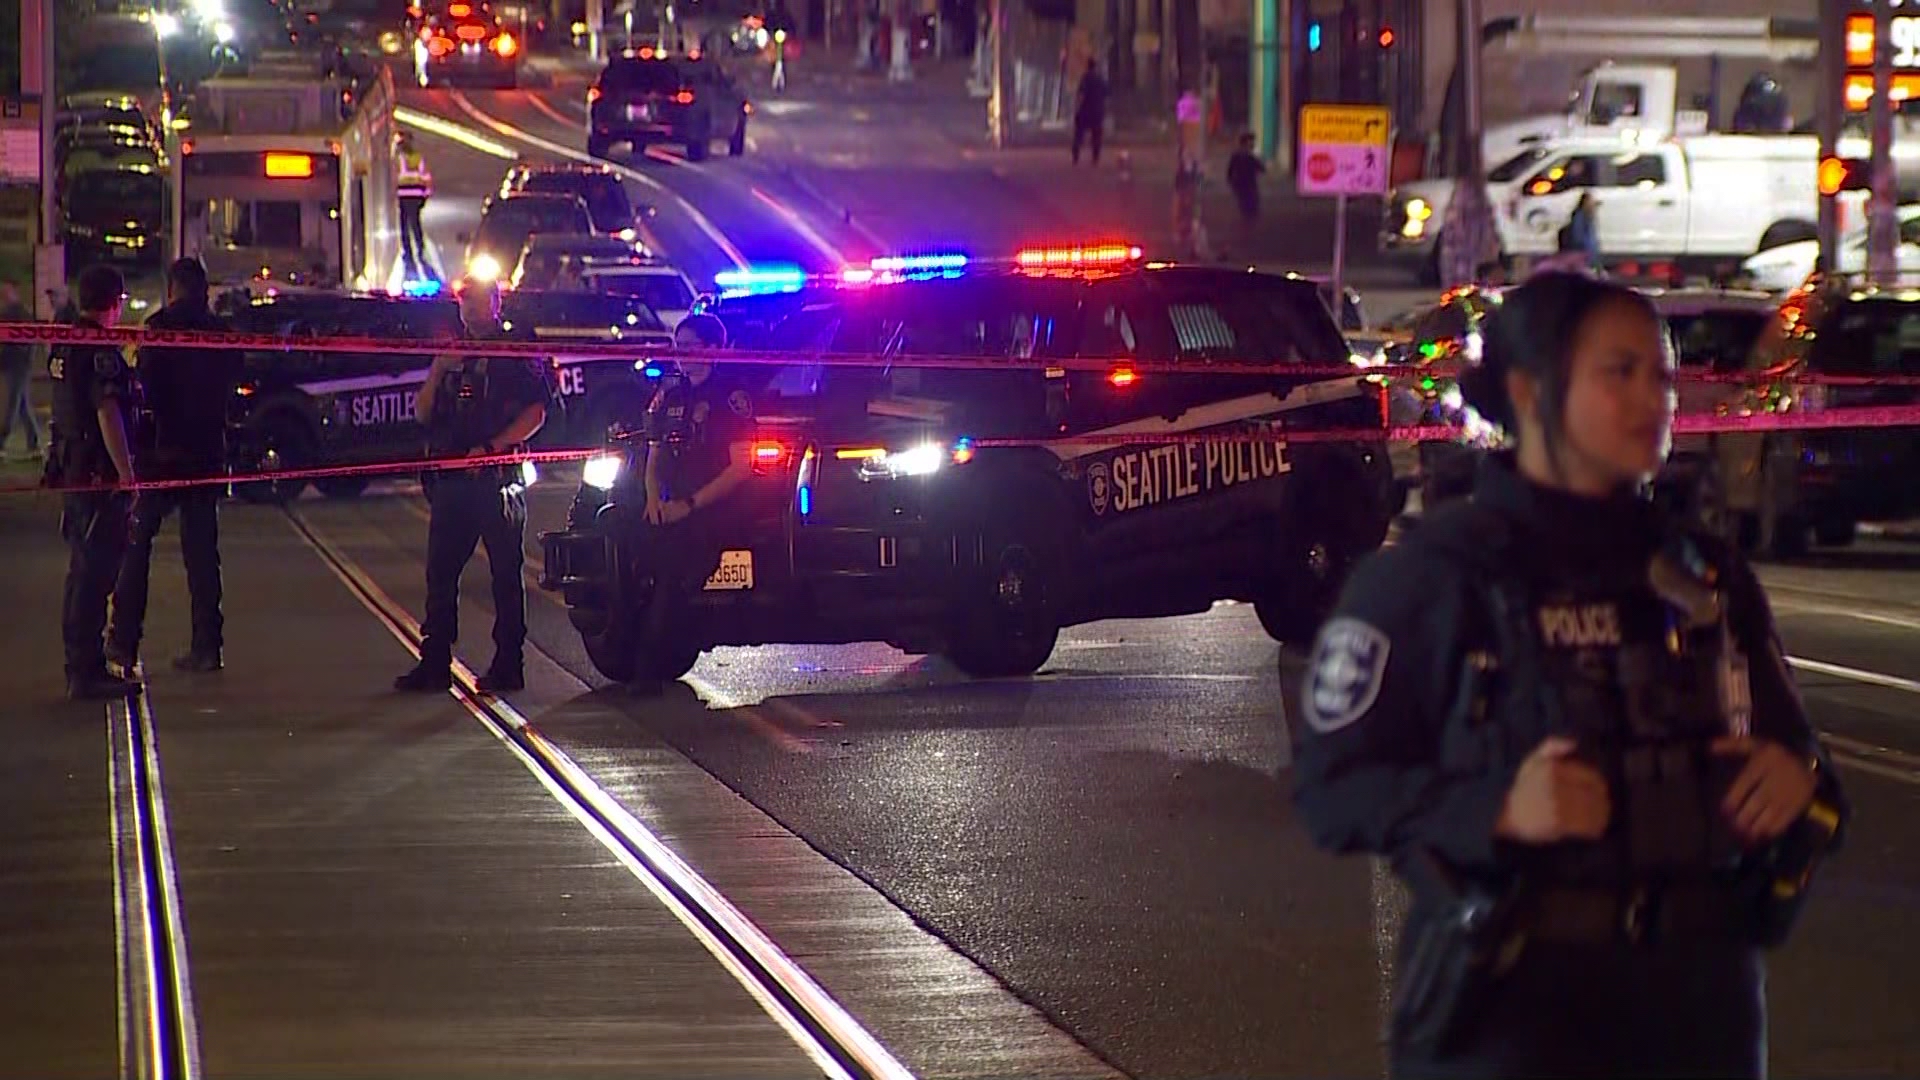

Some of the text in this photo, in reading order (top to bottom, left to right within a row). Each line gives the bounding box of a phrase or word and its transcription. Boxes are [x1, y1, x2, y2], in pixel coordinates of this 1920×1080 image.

[1113, 420, 1292, 512] SEATTLE POLICE
[1540, 605, 1621, 647] POLICE
